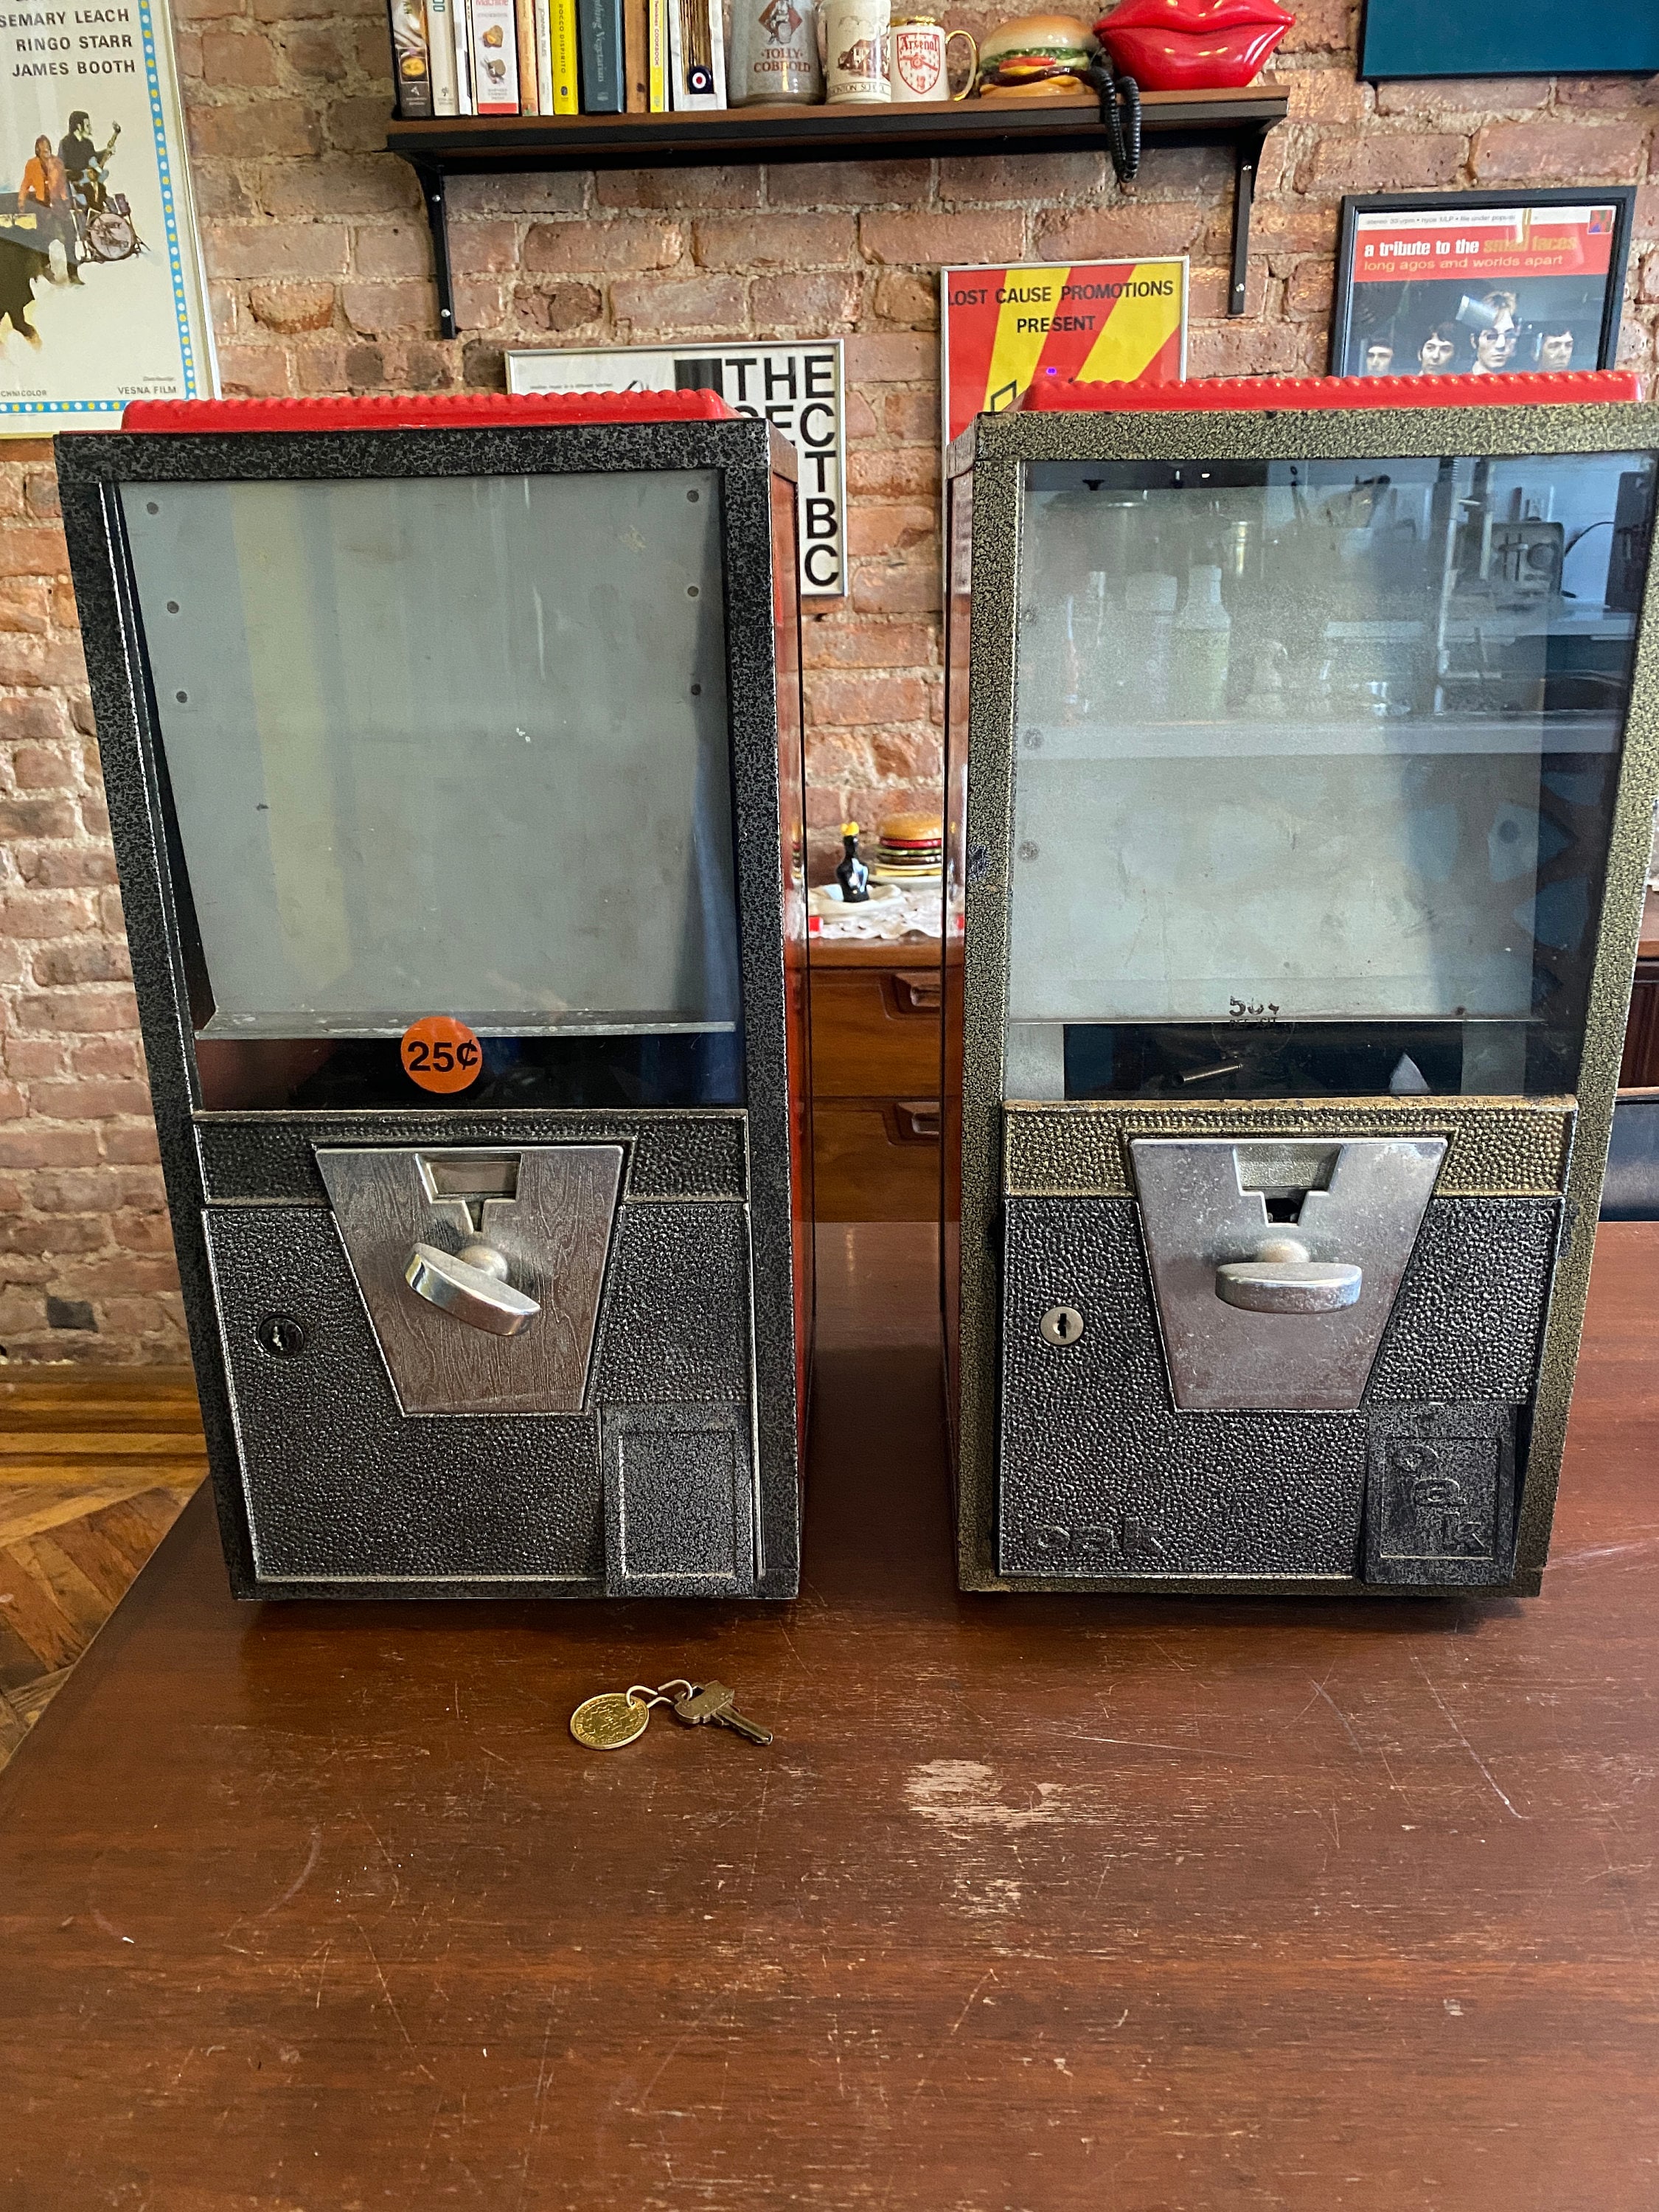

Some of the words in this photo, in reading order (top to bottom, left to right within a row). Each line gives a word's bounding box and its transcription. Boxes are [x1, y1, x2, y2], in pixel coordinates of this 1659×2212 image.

[74, 8, 130, 24] LEACH
[16, 36, 71, 52] RINGO
[79, 34, 133, 49] STARR
[900, 35, 938, 52] Arsenal
[12, 62, 69, 77] JAMES
[77, 59, 136, 74] BOOTH
[1364, 244, 1374, 258] a
[1380, 240, 1430, 257] tribute
[1436, 240, 1450, 254] to
[1455, 238, 1479, 254] the
[1364, 261, 1395, 273] long
[1399, 260, 1436, 272] agos
[1439, 257, 1468, 268] and
[1473, 256, 1520, 268] worlds
[1524, 254, 1563, 268] apart
[948, 289, 988, 306] LOST
[995, 286, 1051, 304] CAUSE
[1061, 280, 1174, 301] PROMOTIONS
[1017, 316, 1096, 333] PRESENT
[725, 355, 835, 401] THE
[118, 386, 149, 394] VESNA
[153, 386, 176, 394] FILM
[407, 1039, 478, 1073] 25¢
